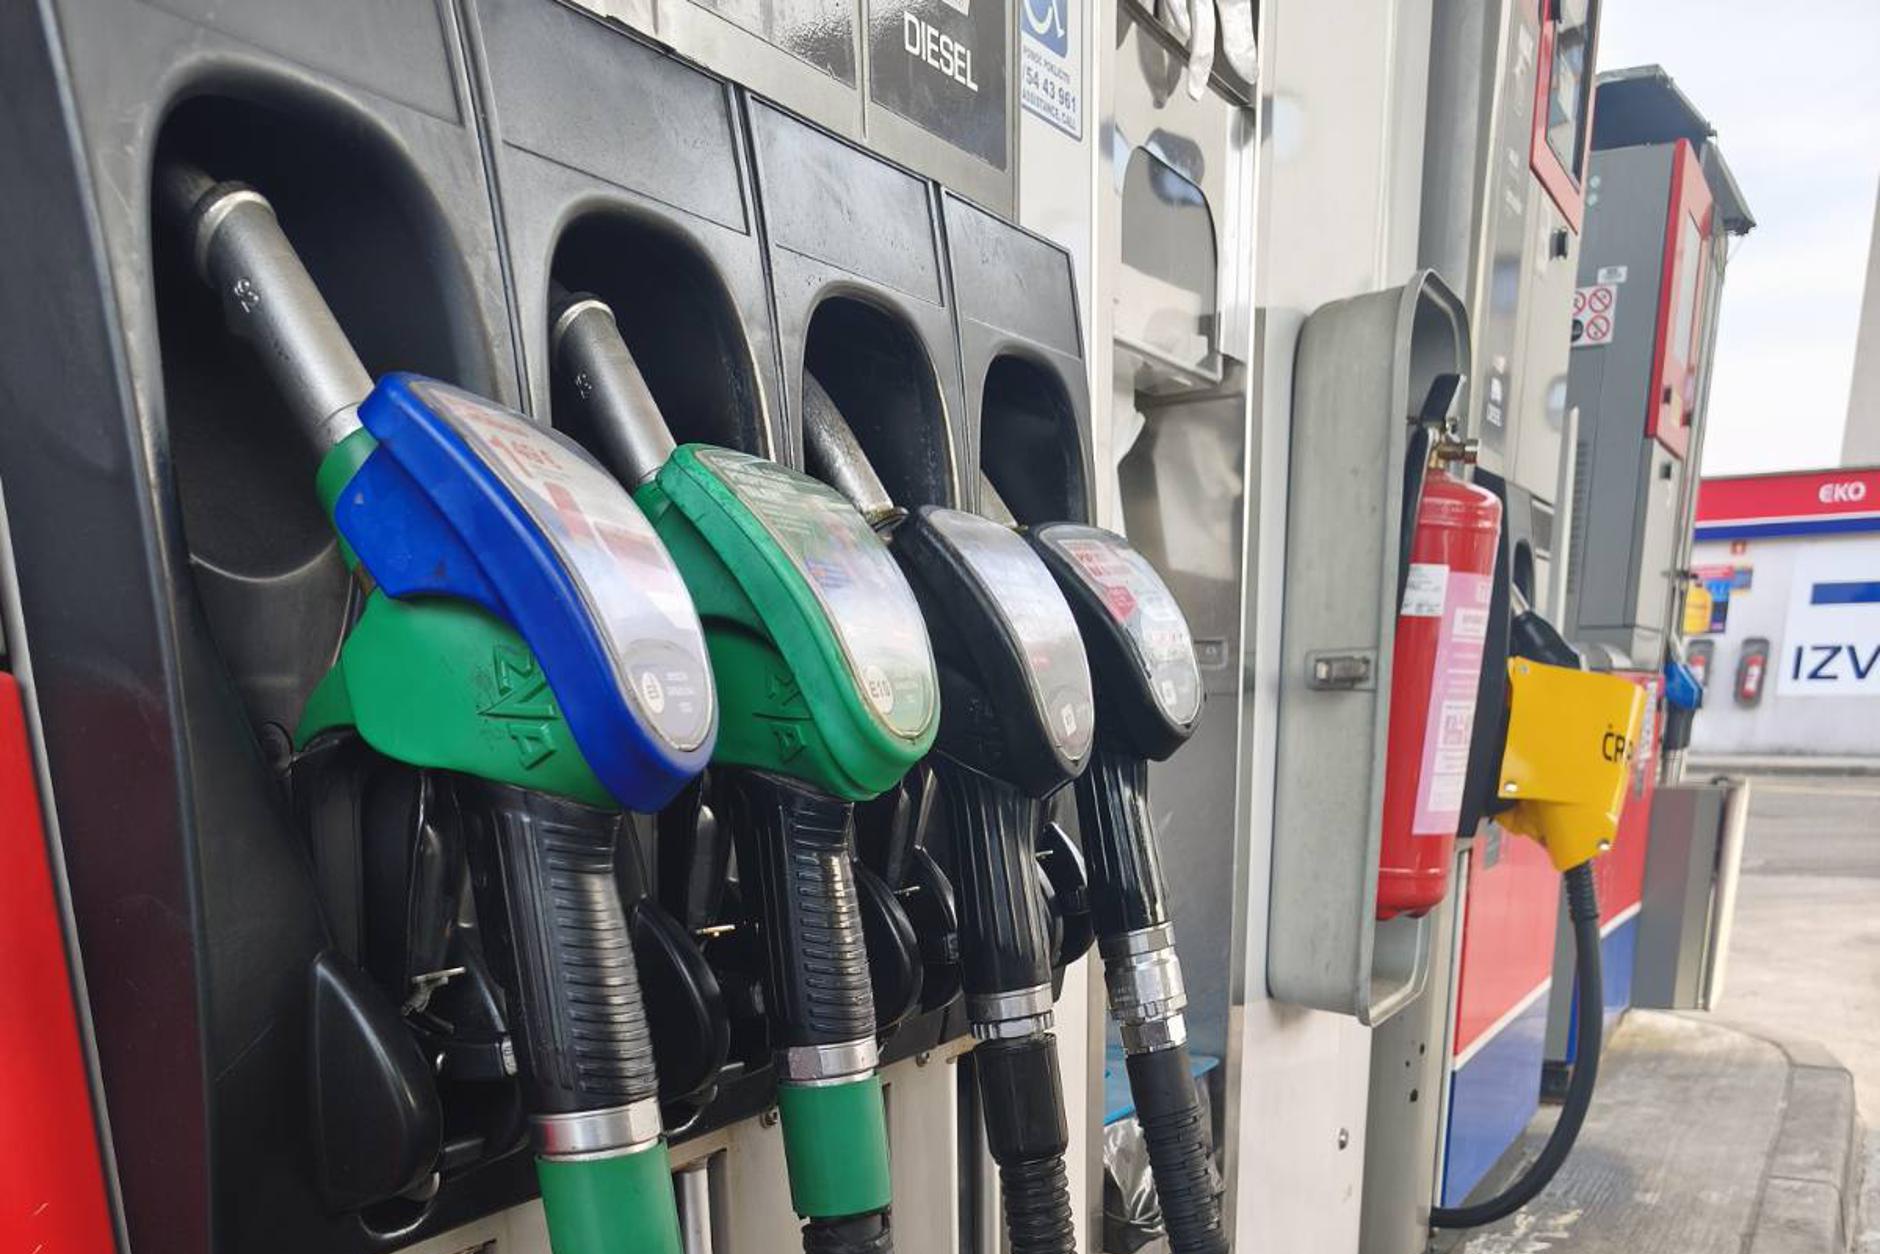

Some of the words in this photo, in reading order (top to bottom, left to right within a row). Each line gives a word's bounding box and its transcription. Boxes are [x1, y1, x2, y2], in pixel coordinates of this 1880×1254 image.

[904, 11, 978, 92] DIESEL
[1042, 78, 1055, 99] 43
[1058, 87, 1076, 113] 961
[1819, 481, 1866, 503] EKO
[1792, 645, 1880, 680] IZV
